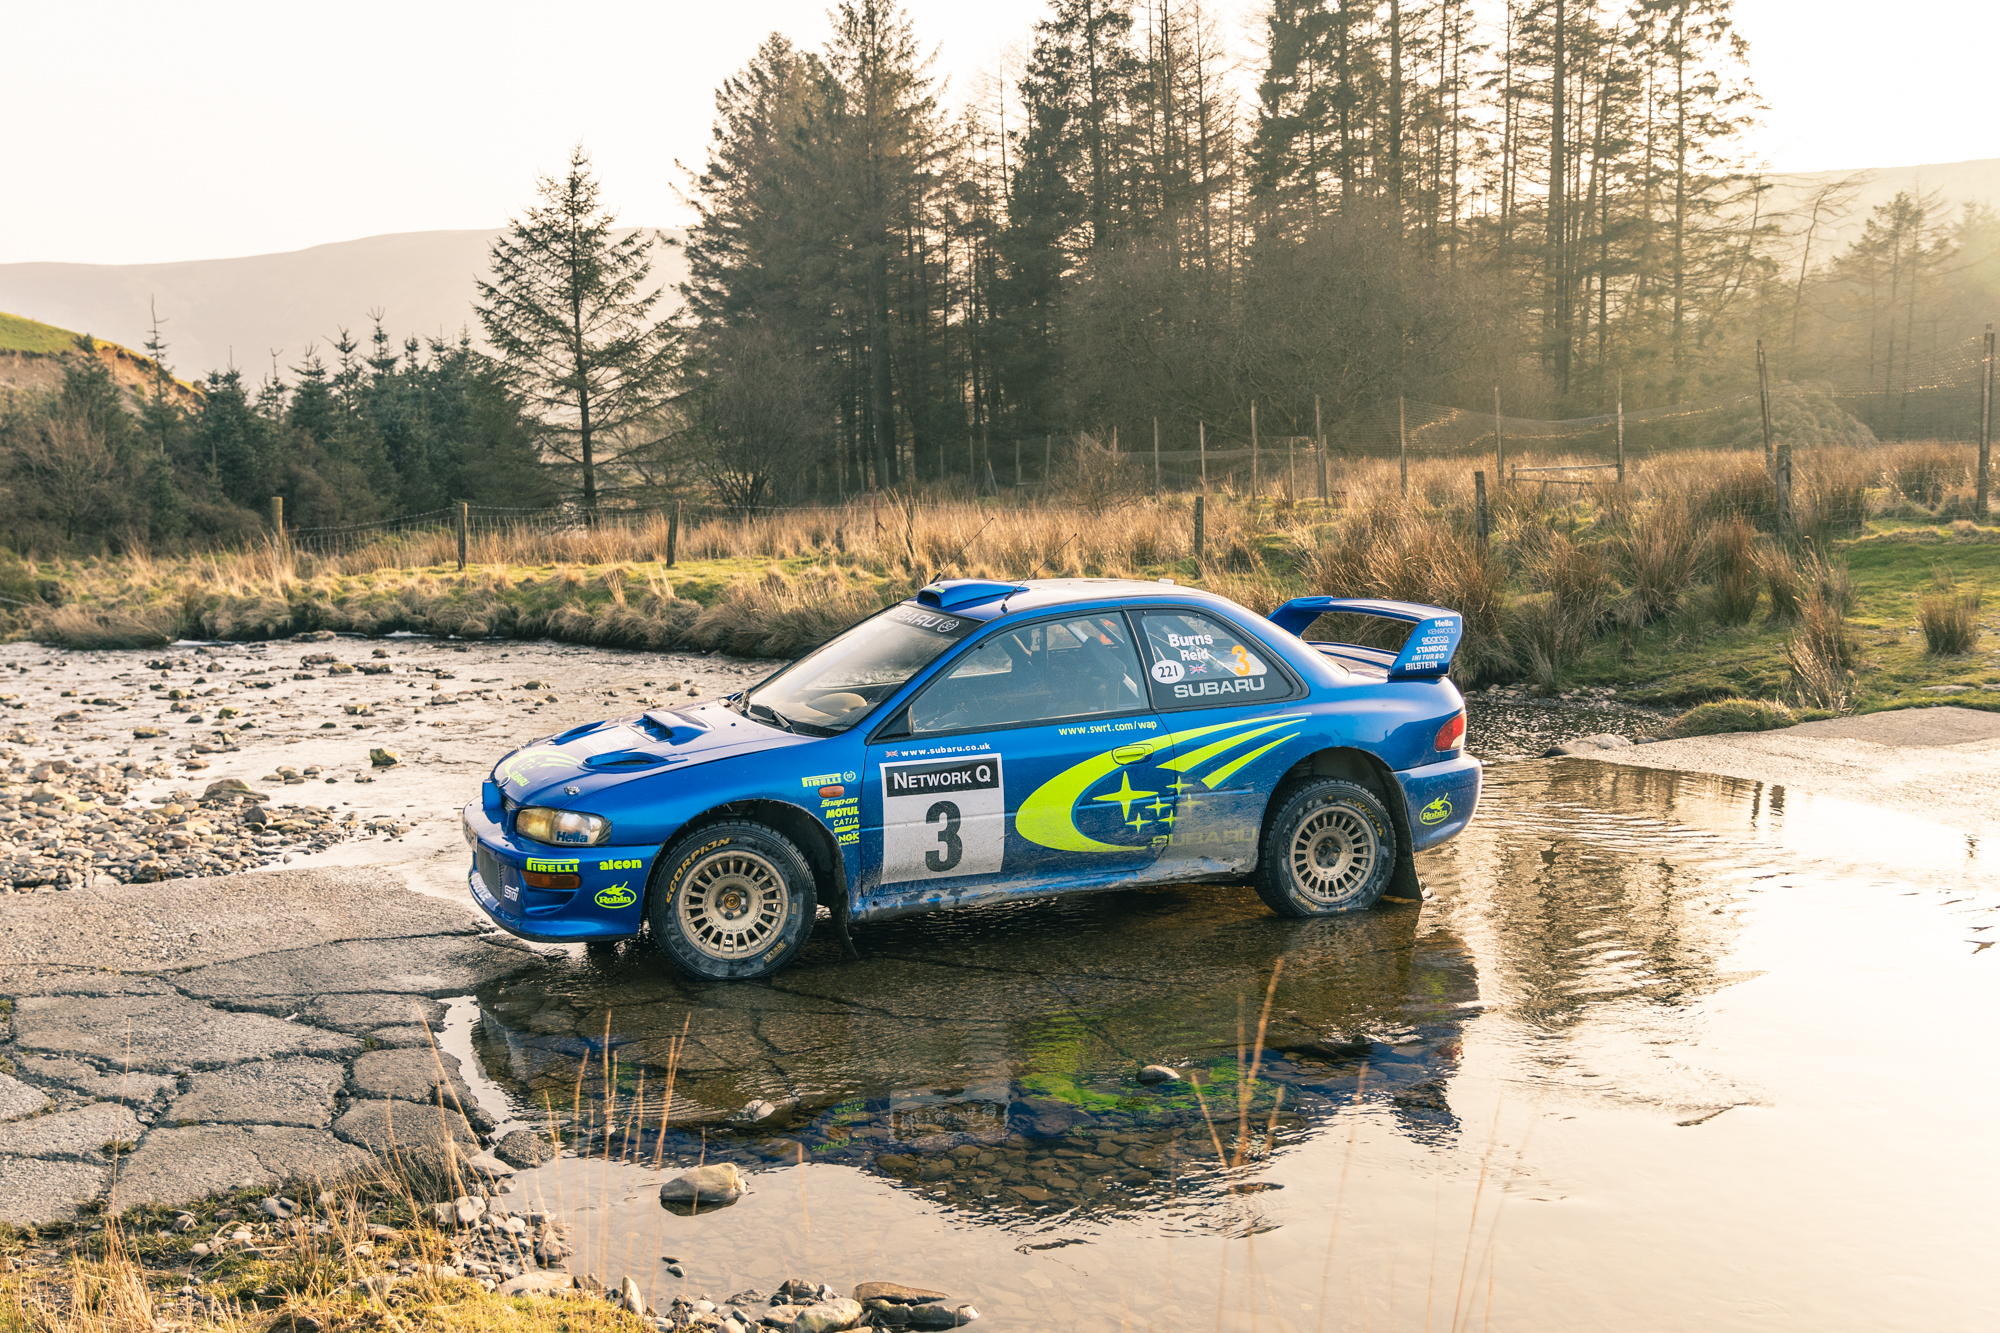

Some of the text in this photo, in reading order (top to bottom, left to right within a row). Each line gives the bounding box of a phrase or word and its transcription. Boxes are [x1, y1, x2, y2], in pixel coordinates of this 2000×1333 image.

[888, 607, 943, 627] UBARU
[1434, 619, 1454, 627] Hella
[1427, 627, 1457, 635] KENWOOD
[1167, 633, 1213, 648] Burns
[1180, 648, 1209, 661] Reid
[1416, 645, 1448, 654] STANDOX
[1231, 645, 1250, 676] 3
[1405, 660, 1438, 670] BILSTEIN
[1158, 665, 1178, 678] 221
[1173, 678, 1265, 698] SUBARU
[1058, 721, 1157, 735] www.swrt.com/wap
[900, 742, 991, 757] www.subaru.co.uk
[975, 765, 991, 782] Q
[801, 773, 841, 788] PIRELLI
[826, 806, 859, 819] MOTUL
[1422, 810, 1448, 820] Robin
[833, 817, 859, 826] CATIA
[556, 830, 588, 843] Hella
[838, 832, 860, 842] NGK
[925, 800, 963, 872] 3
[526, 857, 580, 873] PIRELLI
[599, 859, 642, 871] alcon
[598, 895, 632, 904] Robin
